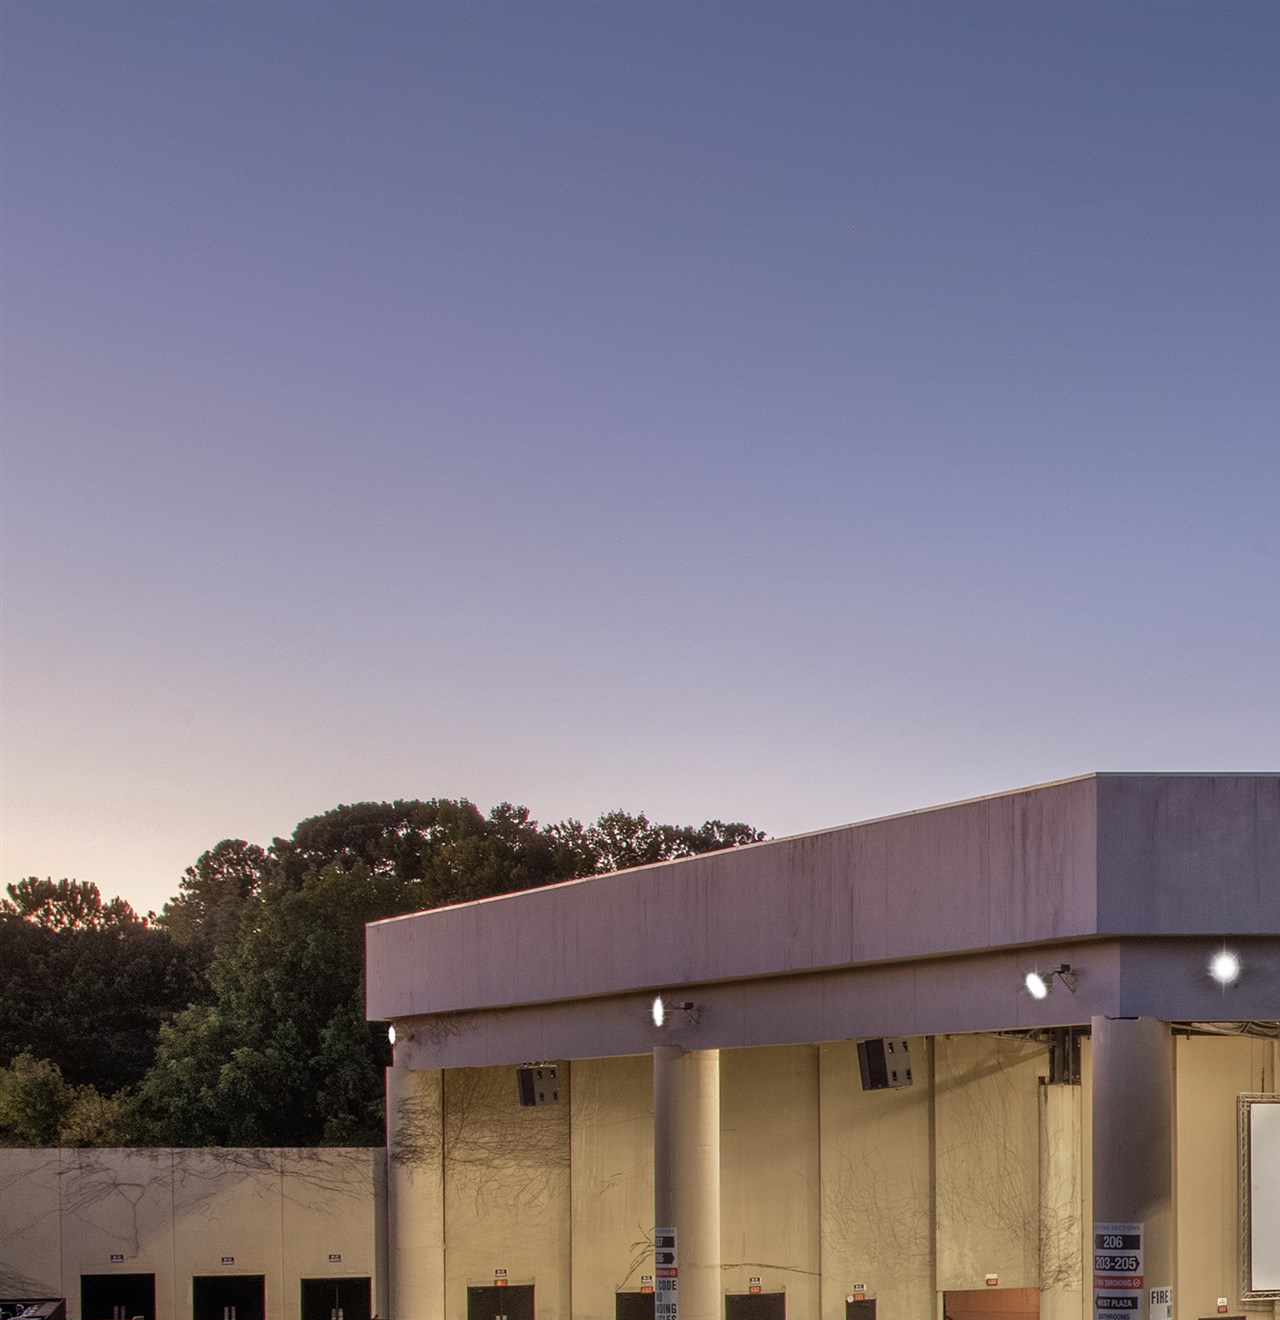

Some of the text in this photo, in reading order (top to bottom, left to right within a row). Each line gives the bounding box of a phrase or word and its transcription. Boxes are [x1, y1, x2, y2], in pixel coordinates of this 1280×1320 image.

[1103, 1235, 1123, 1248] 206
[1095, 1256, 1137, 1270] 203-205
[1111, 1299, 1133, 1307] PLAZA
[1151, 1290, 1169, 1304] FIRE
